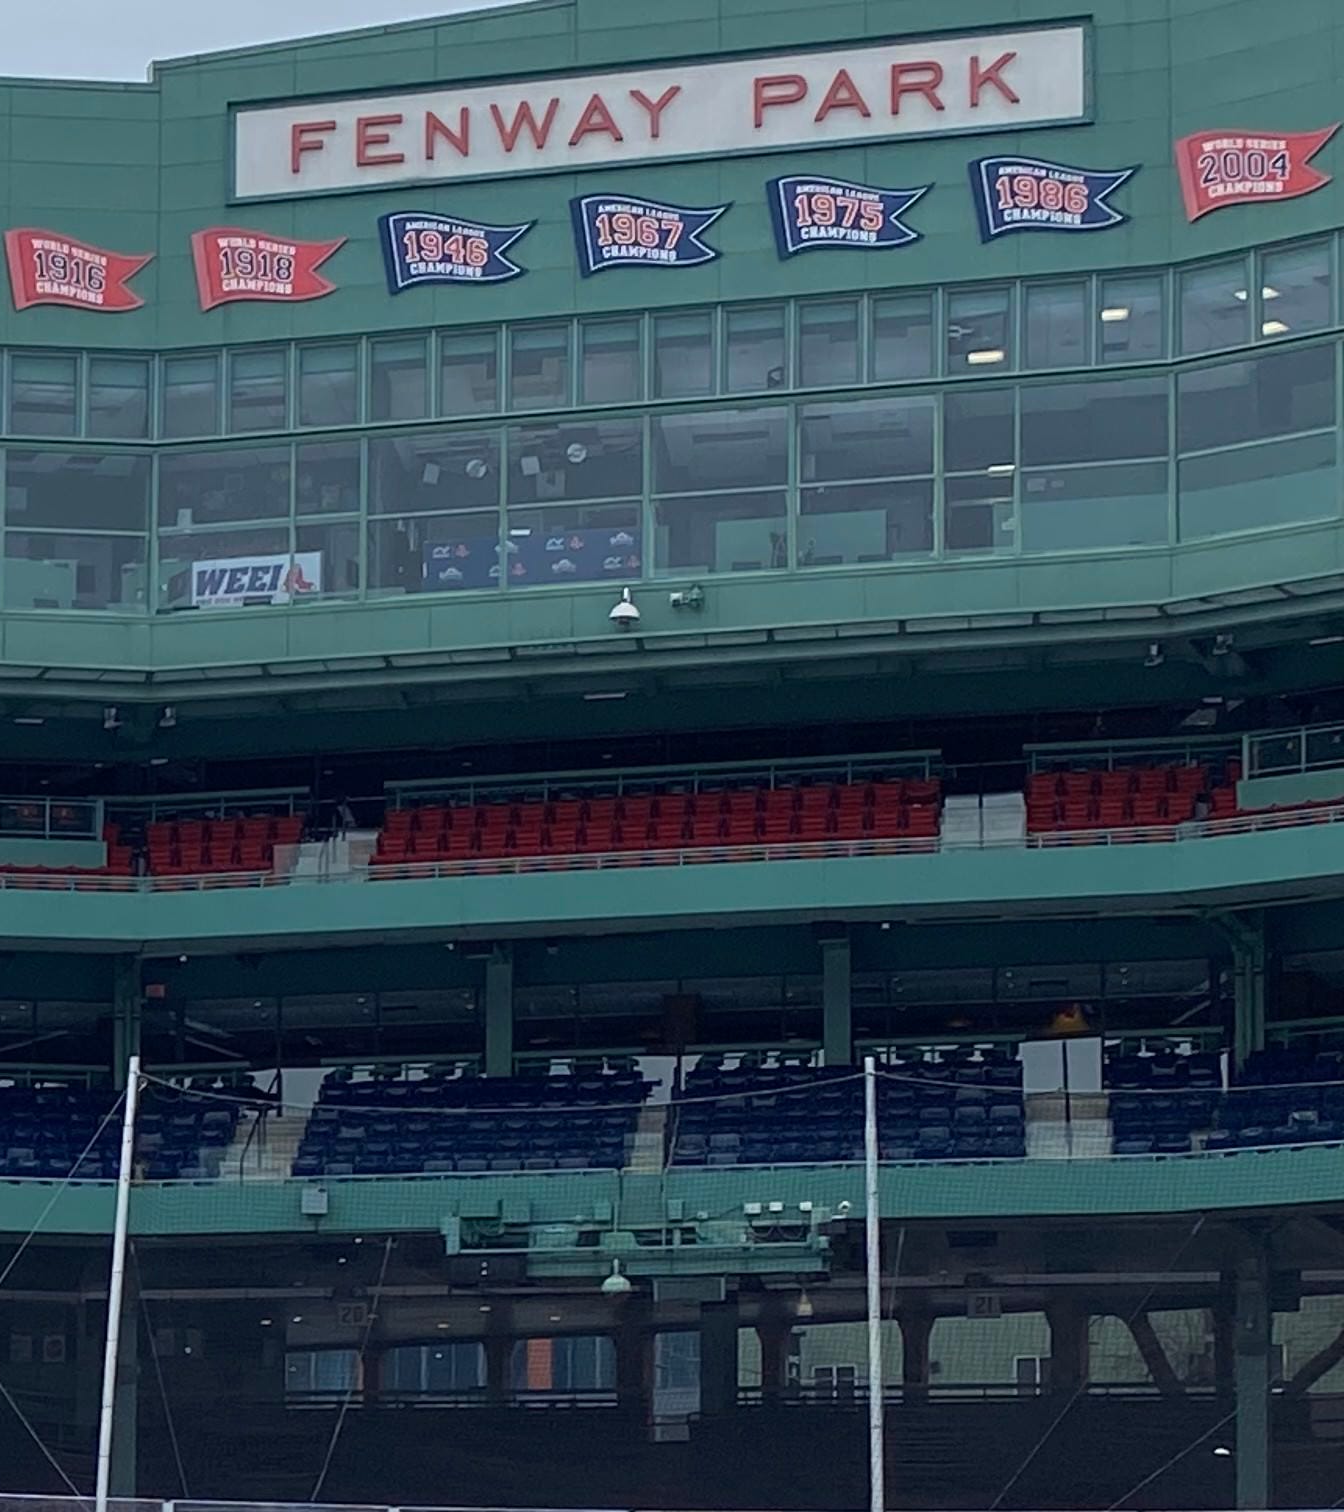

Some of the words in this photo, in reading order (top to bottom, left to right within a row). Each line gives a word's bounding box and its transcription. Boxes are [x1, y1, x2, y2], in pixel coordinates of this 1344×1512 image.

[291, 85, 681, 173] FENWAY
[753, 52, 1020, 128] PARK
[1198, 149, 1290, 187] 2004
[996, 175, 1087, 213] 1986
[1208, 180, 1283, 198] CHAMPIONS
[794, 194, 883, 231] 1975
[1003, 208, 1081, 225] CHAMPIONS
[403, 230, 488, 266] 1946
[596, 213, 683, 249] 1967
[800, 226, 877, 242] CHAMPIONS
[219, 247, 293, 281] 1918
[409, 261, 482, 278] CHAMPIONS
[602, 244, 676, 261] CHAMPIONS
[32, 249, 105, 292] 1916
[222, 278, 292, 295] CHAMPIONS
[36, 280, 103, 304] CHAMPIONS
[195, 563, 285, 597] WEEI
